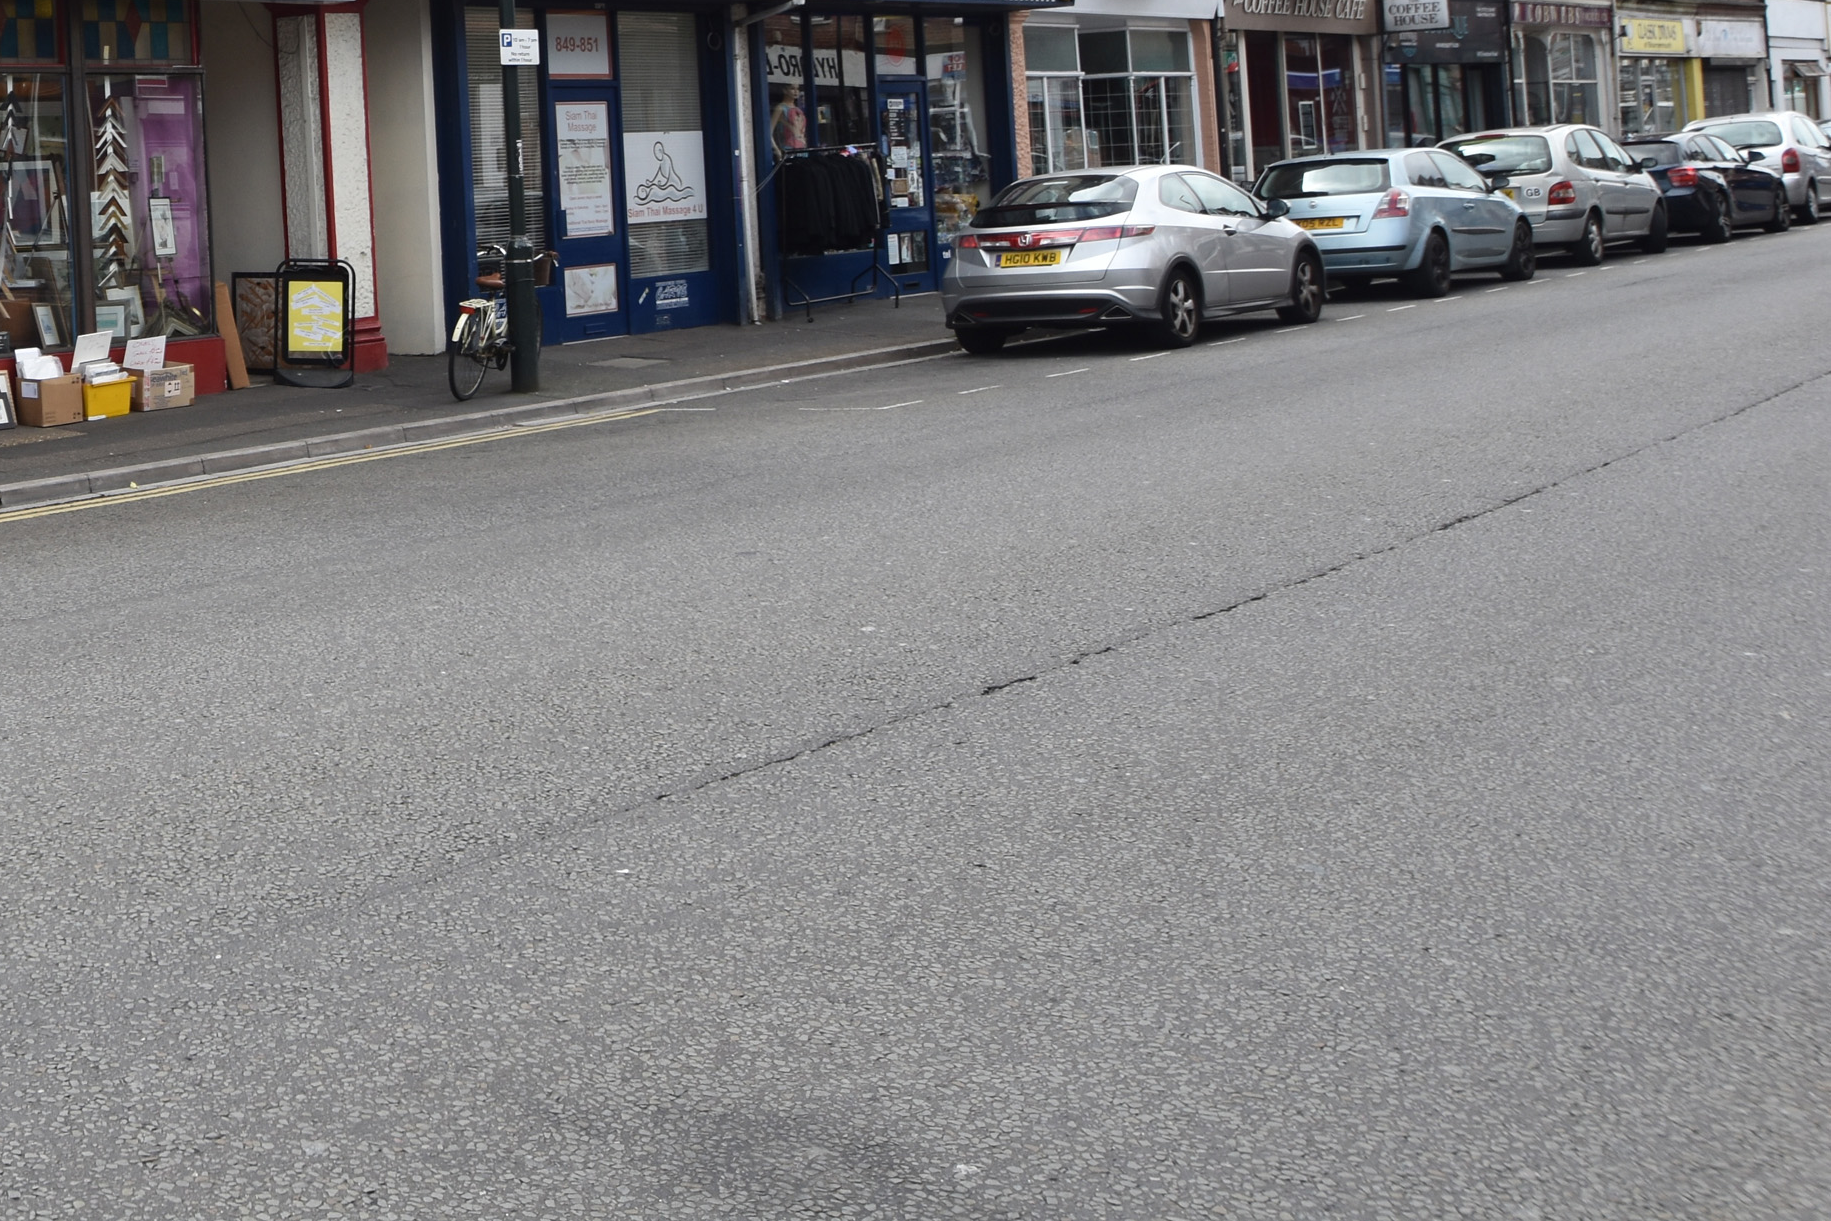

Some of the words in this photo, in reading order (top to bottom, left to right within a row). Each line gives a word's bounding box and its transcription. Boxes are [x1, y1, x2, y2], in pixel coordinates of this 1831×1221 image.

[1388, 2, 1441, 15] COFFEE
[1393, 13, 1439, 26] HOUSE
[504, 34, 511, 46] P
[555, 36, 599, 52] 849-851
[565, 111, 581, 120] Siam
[583, 110, 597, 120] Thai
[568, 123, 596, 133] Massage
[1526, 188, 1540, 197] GB
[628, 208, 644, 218] Siam
[646, 207, 661, 216] Thai
[663, 206, 691, 216] Massage
[692, 204, 697, 213] 4
[698, 204, 703, 213] U
[1005, 254, 1030, 264] HG10
[1033, 252, 1057, 264] KWB
